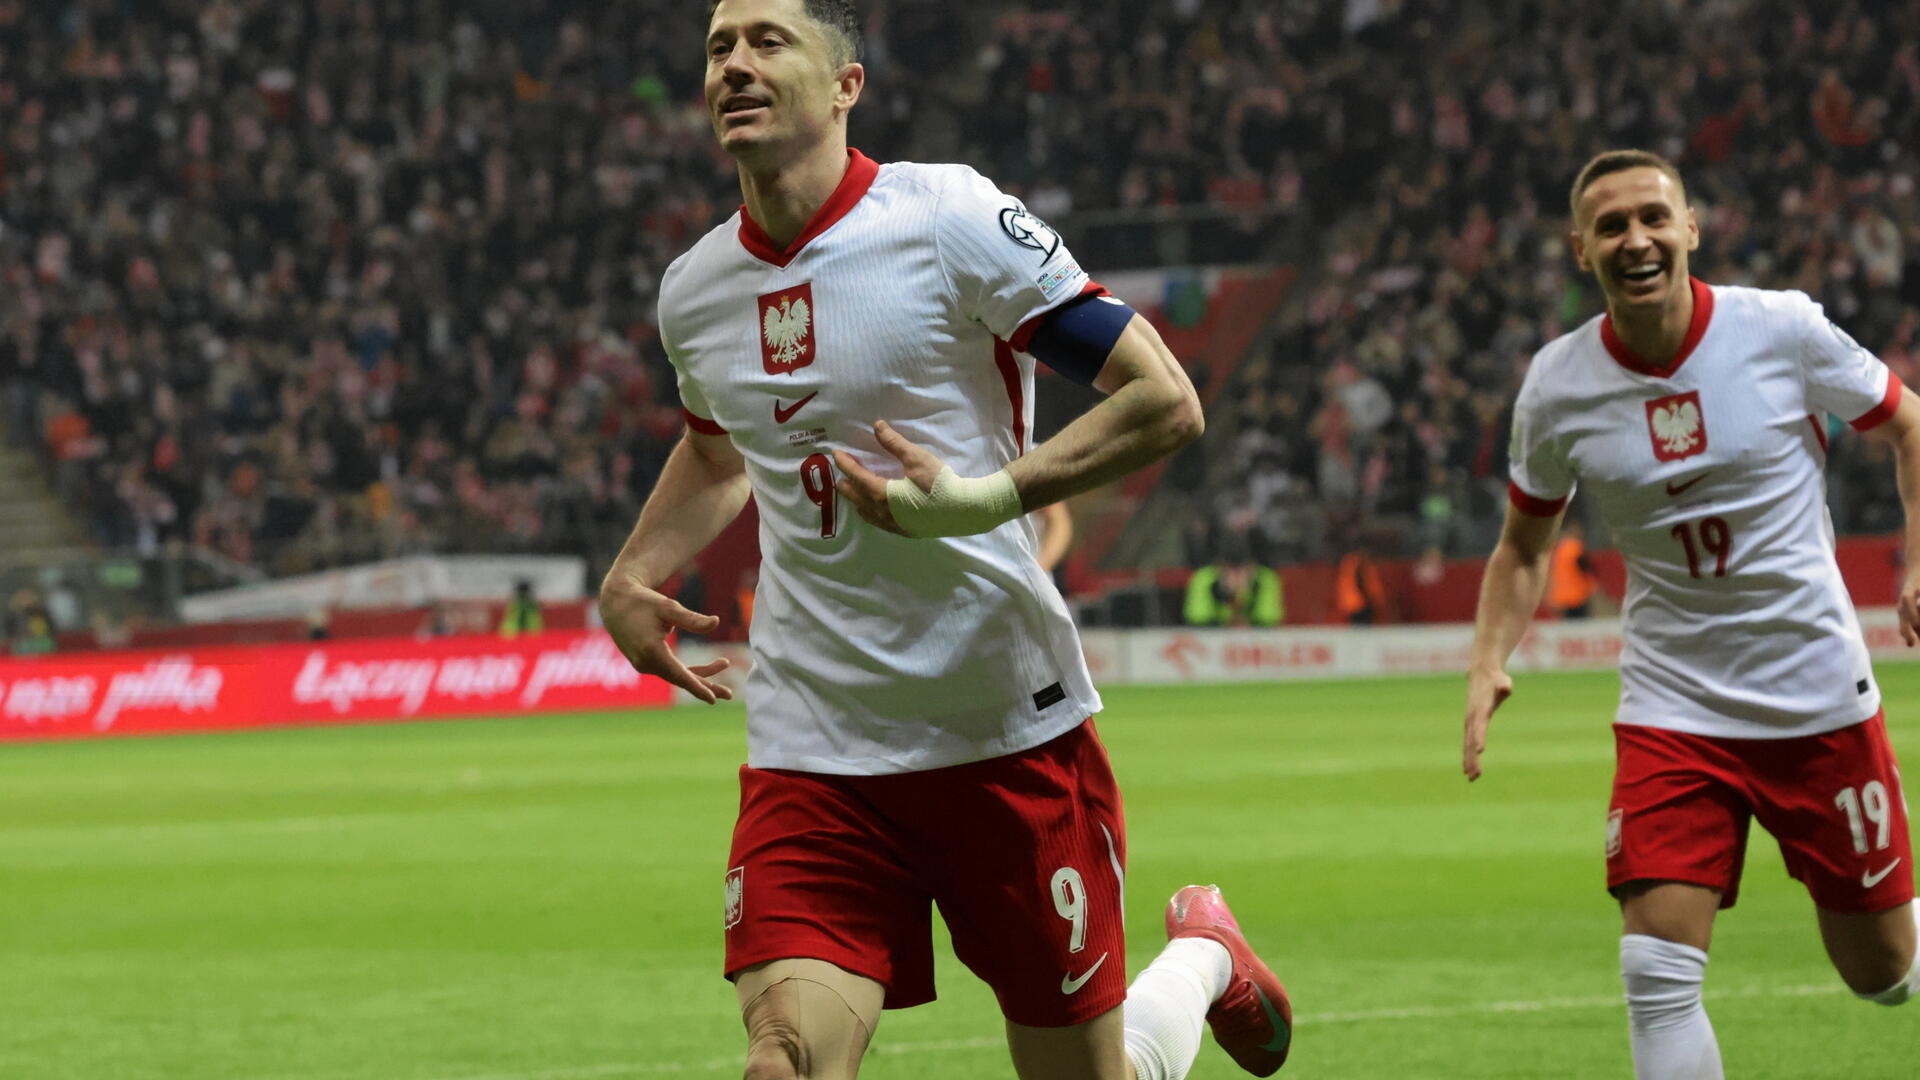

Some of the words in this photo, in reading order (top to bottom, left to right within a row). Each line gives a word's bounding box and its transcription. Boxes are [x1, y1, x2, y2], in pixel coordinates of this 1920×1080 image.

[800, 453, 838, 539] 9
[1671, 516, 1732, 579] 19
[1834, 780, 1890, 854] 19
[1050, 867, 1088, 953] 9
